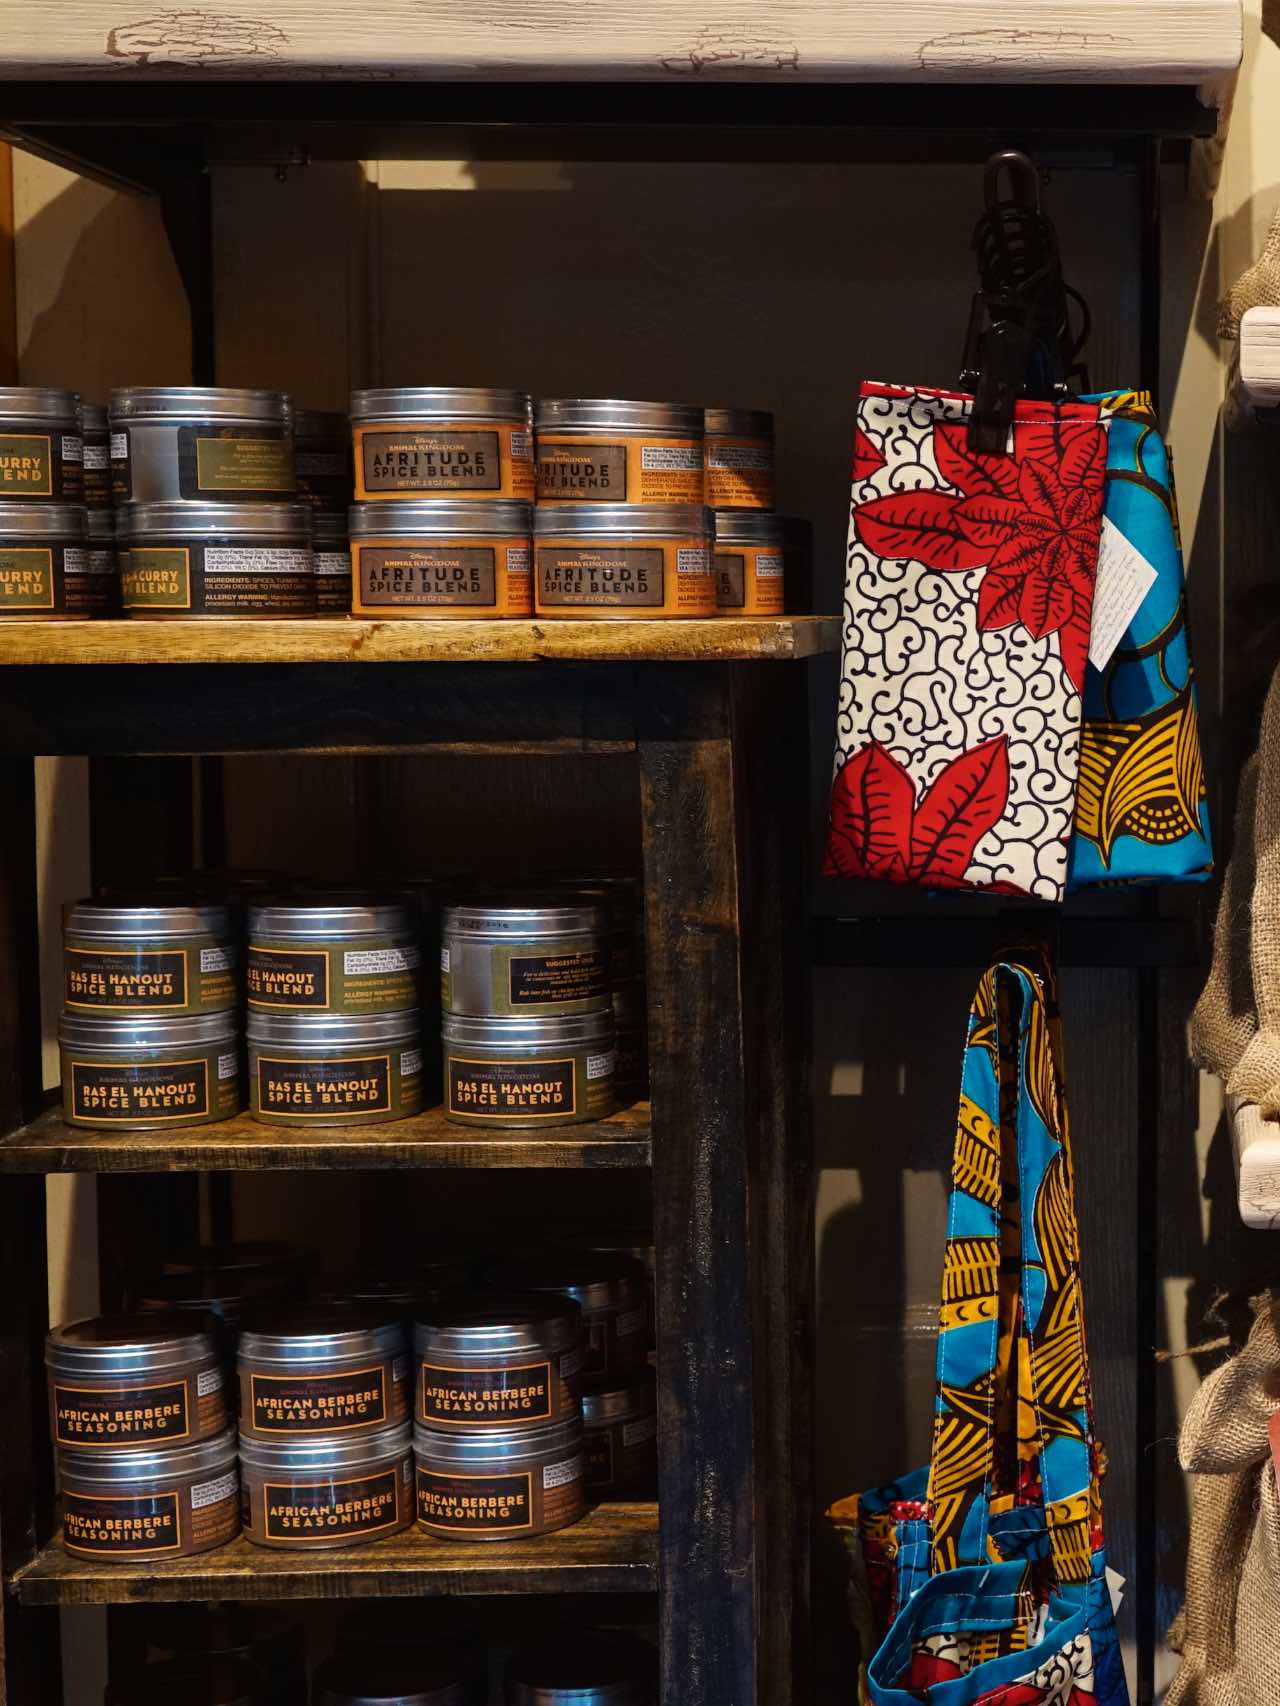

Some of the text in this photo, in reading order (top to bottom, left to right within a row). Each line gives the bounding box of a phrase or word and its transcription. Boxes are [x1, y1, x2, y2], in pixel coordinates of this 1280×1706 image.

[0, 457, 41, 470] URRY
[373, 452, 486, 466] AFRITUDE
[373, 466, 487, 478] SPICE BLEND
[561, 477, 610, 488] BLEND
[0, 571, 42, 583] URRY
[138, 570, 179, 583] CURRY
[369, 567, 480, 581] AFRITUDE
[545, 568, 648, 582] AFRITUDE
[369, 581, 481, 593] SPICE BLEND
[544, 582, 649, 593] SPICE BLEND
[71, 971, 173, 985] RAS EL HANOUT
[262, 971, 315, 984] HANOUT
[71, 982, 173, 996] SPICE BLEND
[266, 983, 315, 995] BLEND
[83, 1082, 196, 1097] RAS EL HANOUT
[268, 1078, 378, 1092] RAS EL HANOUT
[457, 1080, 563, 1094] RAS EL HANOUT
[83, 1094, 196, 1108] SPICE BLEND
[268, 1090, 379, 1103] SPICE BLEND
[457, 1091, 563, 1104] SPICE BLEND
[256, 1389, 379, 1409] AFRICAN BERBERE
[426, 1385, 545, 1401] AFRICAN BERBERE
[267, 1403, 368, 1420] SEASONING
[435, 1398, 532, 1412] SEASONING
[58, 1404, 181, 1422] AFRICAN BERBERE
[67, 1418, 167, 1433] SEASONING
[270, 1492, 393, 1516] AFRICAN BERBERE
[462, 1495, 525, 1508] BERBERE
[282, 1506, 382, 1528] SEASONING
[424, 1502, 511, 1519] SEASONING
[106, 1515, 172, 1530] BERBERE
[68, 1525, 157, 1541] SEASONING
